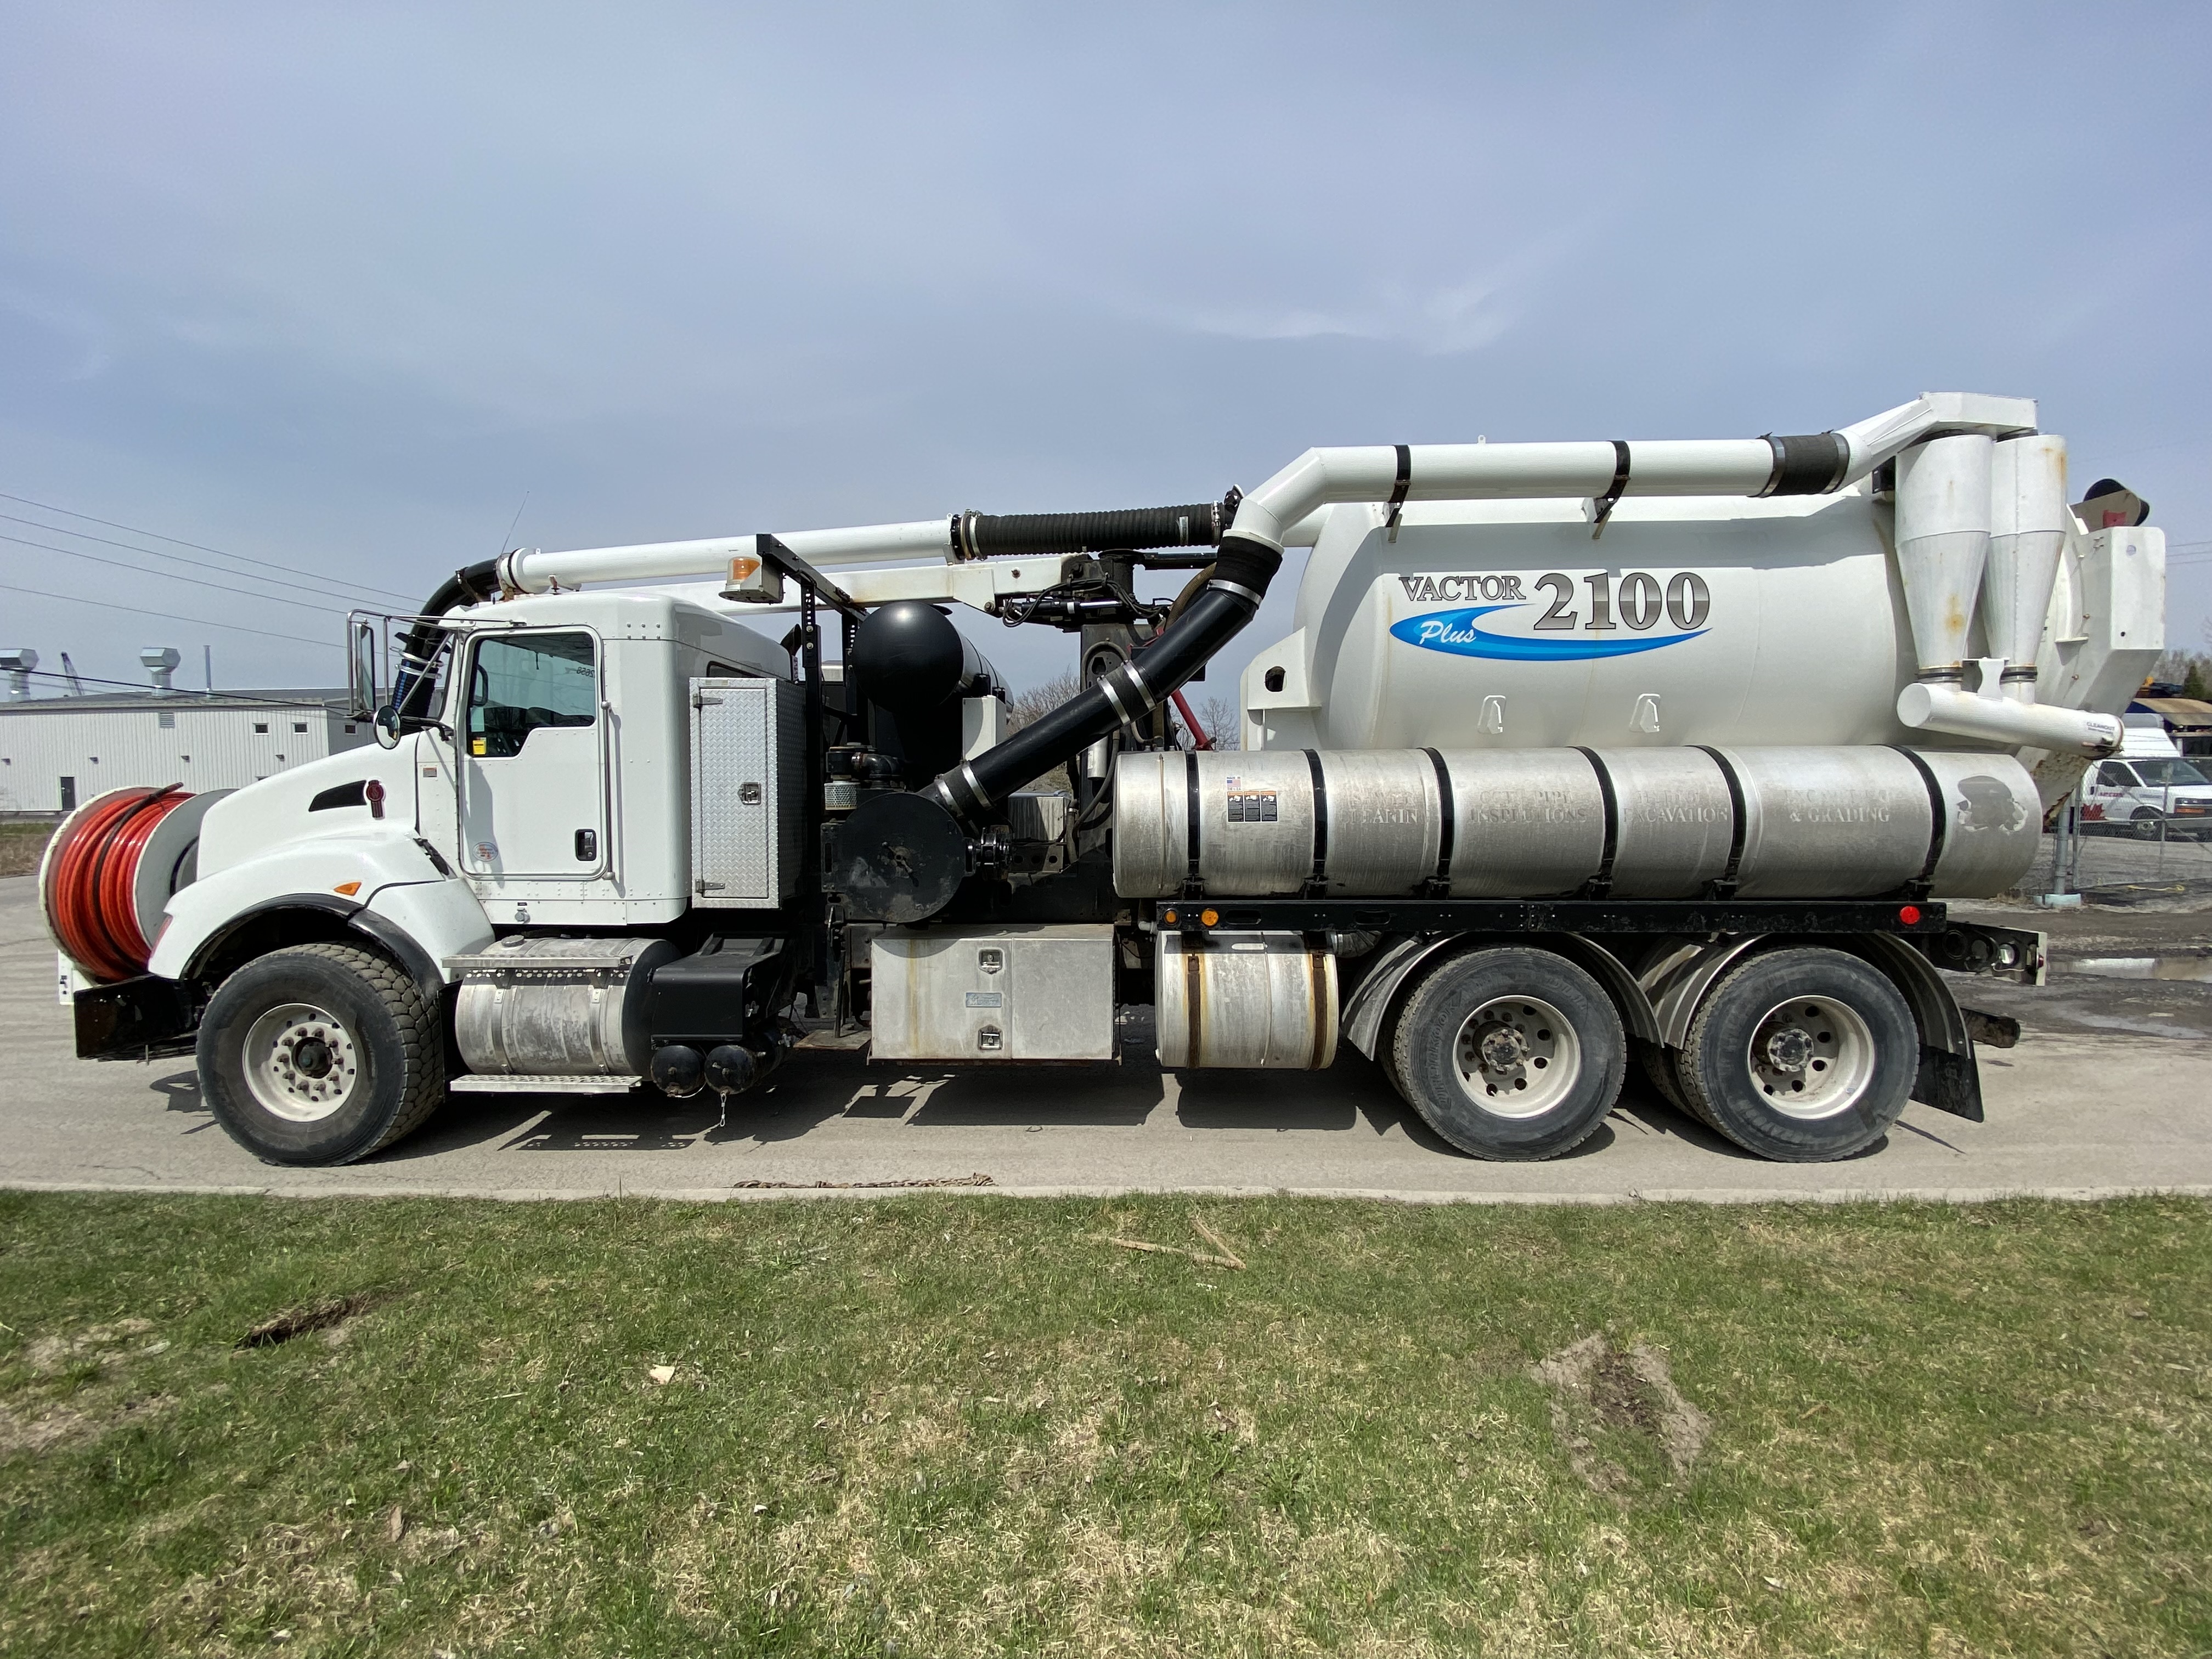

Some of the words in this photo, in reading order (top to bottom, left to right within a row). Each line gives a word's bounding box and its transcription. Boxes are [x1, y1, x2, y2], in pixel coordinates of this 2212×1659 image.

[1398, 575, 1526, 601] VACTOR
[1533, 572, 1710, 630] 2100
[1419, 620, 1477, 645] Plus
